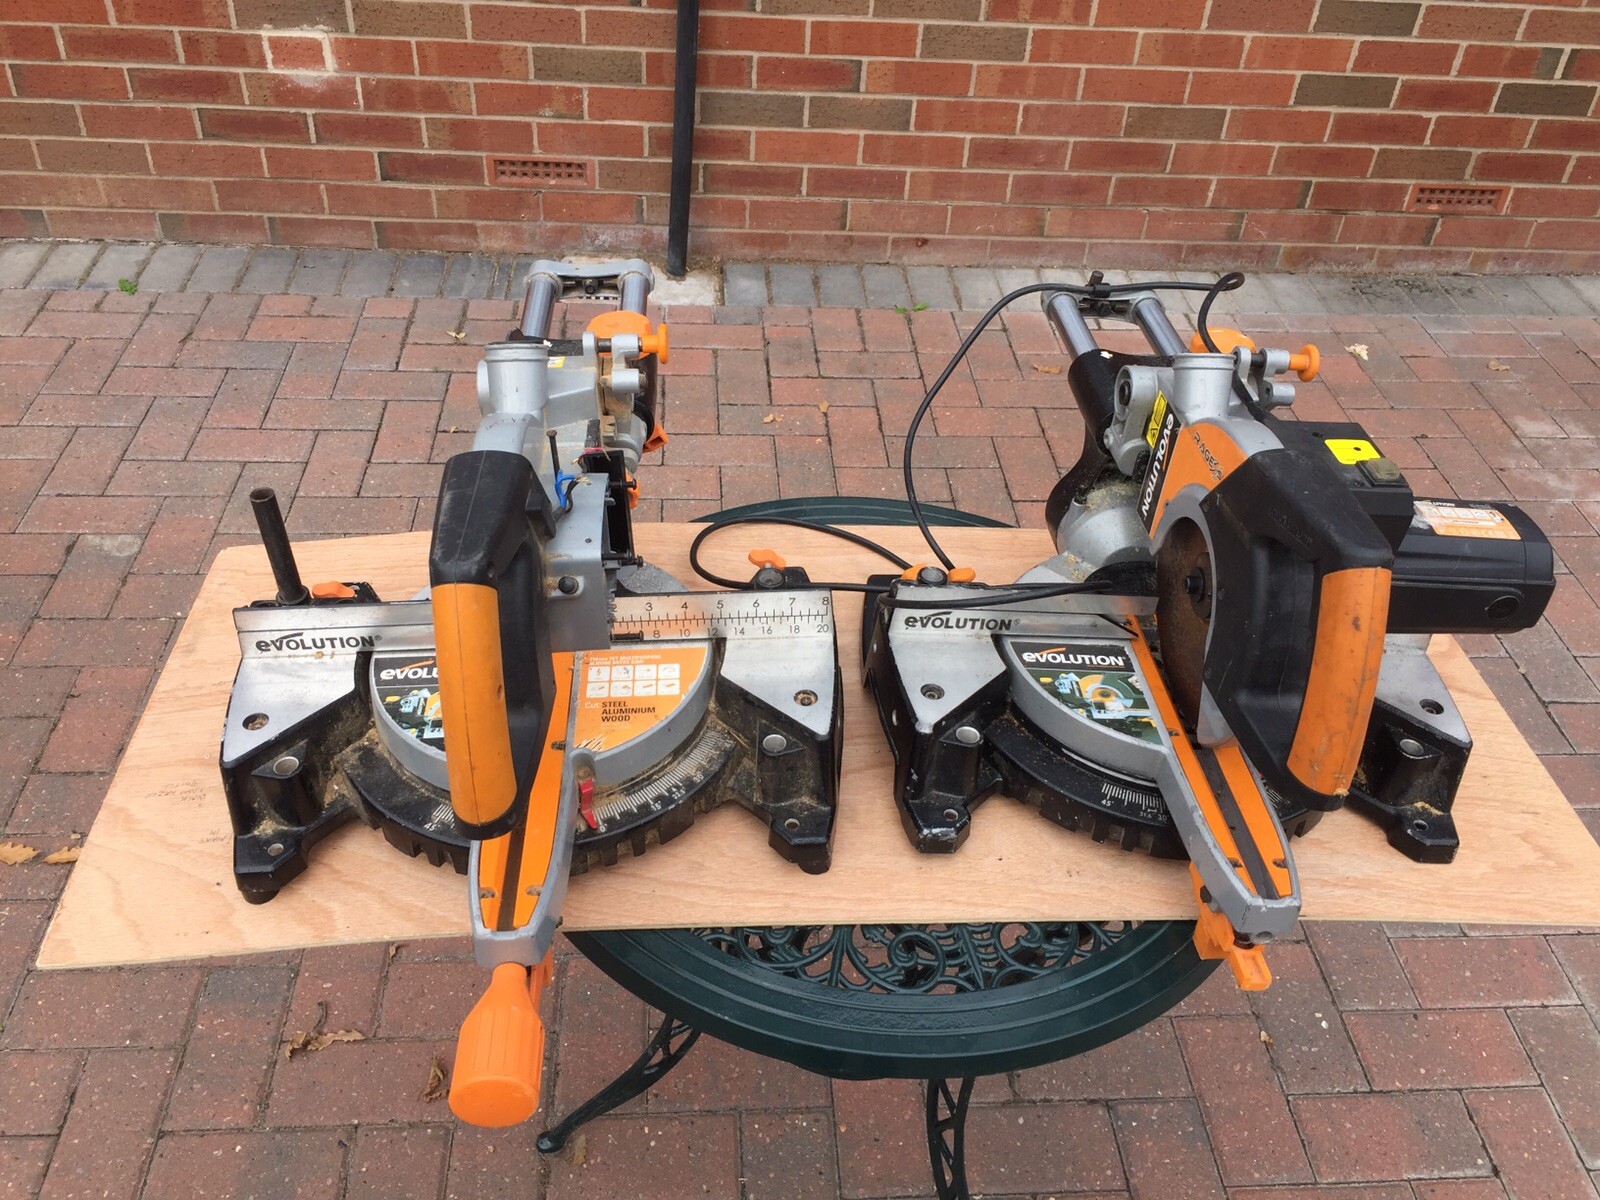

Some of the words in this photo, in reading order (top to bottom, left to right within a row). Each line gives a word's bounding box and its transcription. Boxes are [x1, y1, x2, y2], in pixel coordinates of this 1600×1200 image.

[645, 602, 653, 612] 3
[681, 601, 688, 610] 4
[716, 600, 724, 609] 5
[752, 598, 760, 608] 6
[788, 597, 796, 606] 7
[822, 596, 830, 606] 8
[653, 629, 661, 639] 8
[679, 628, 691, 638] 10
[707, 627, 718, 637] 12
[734, 627, 745, 636] 14
[761, 626, 773, 635] 16
[789, 625, 801, 634] 18
[816, 624, 829, 633] 20
[601, 707, 656, 716] ALUMINIUM
[601, 714, 631, 723] WOOD
